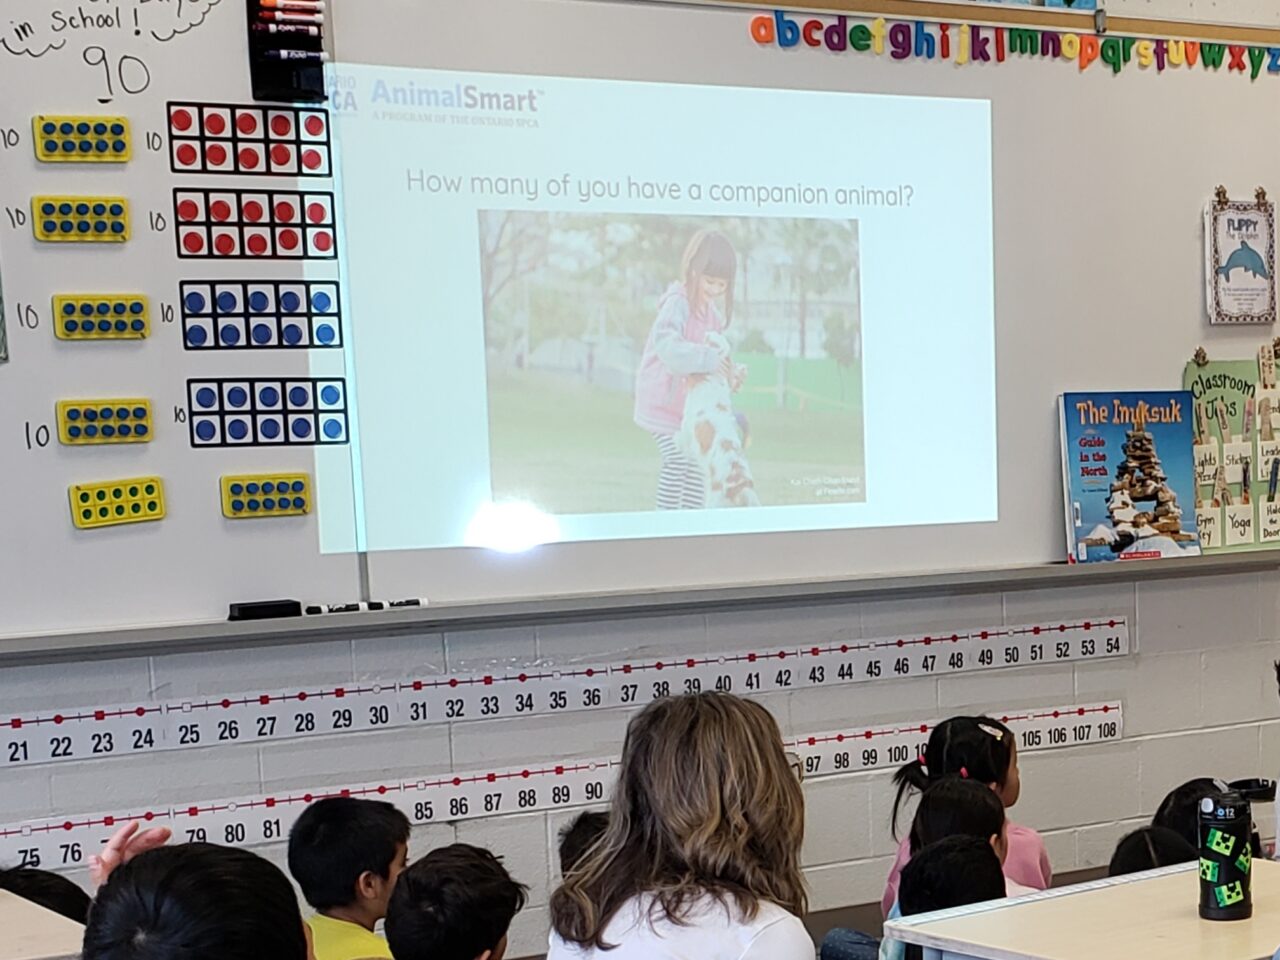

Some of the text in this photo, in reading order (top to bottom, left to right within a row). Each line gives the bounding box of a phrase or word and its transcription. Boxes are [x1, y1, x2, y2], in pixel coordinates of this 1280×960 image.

[14, 21, 34, 42] in
[83, 46, 150, 95] 90
[1, 129, 19, 148] 10
[147, 132, 162, 151] 10
[407, 168, 915, 207] How many of you have a companion animal?
[6, 207, 26, 229] 10
[150, 212, 166, 231] 10
[17, 303, 39, 329] 10
[161, 303, 174, 323] 10
[1191, 373, 1256, 400] Classroom
[174, 406, 186, 424] 10
[1076, 400, 1182, 424] The Inuksuk
[25, 421, 50, 450] 10
[1079, 437, 1105, 448] Guide
[1080, 452, 1106, 462] in the
[1081, 466, 1108, 477] North
[1229, 515, 1251, 537] Yoga
[8, 637, 1120, 762] 21 23 24 26 27 28 30 32 35 36 41 43 44 50 54
[60, 723, 1116, 864] 76 81 85 90 97 100 105 108
